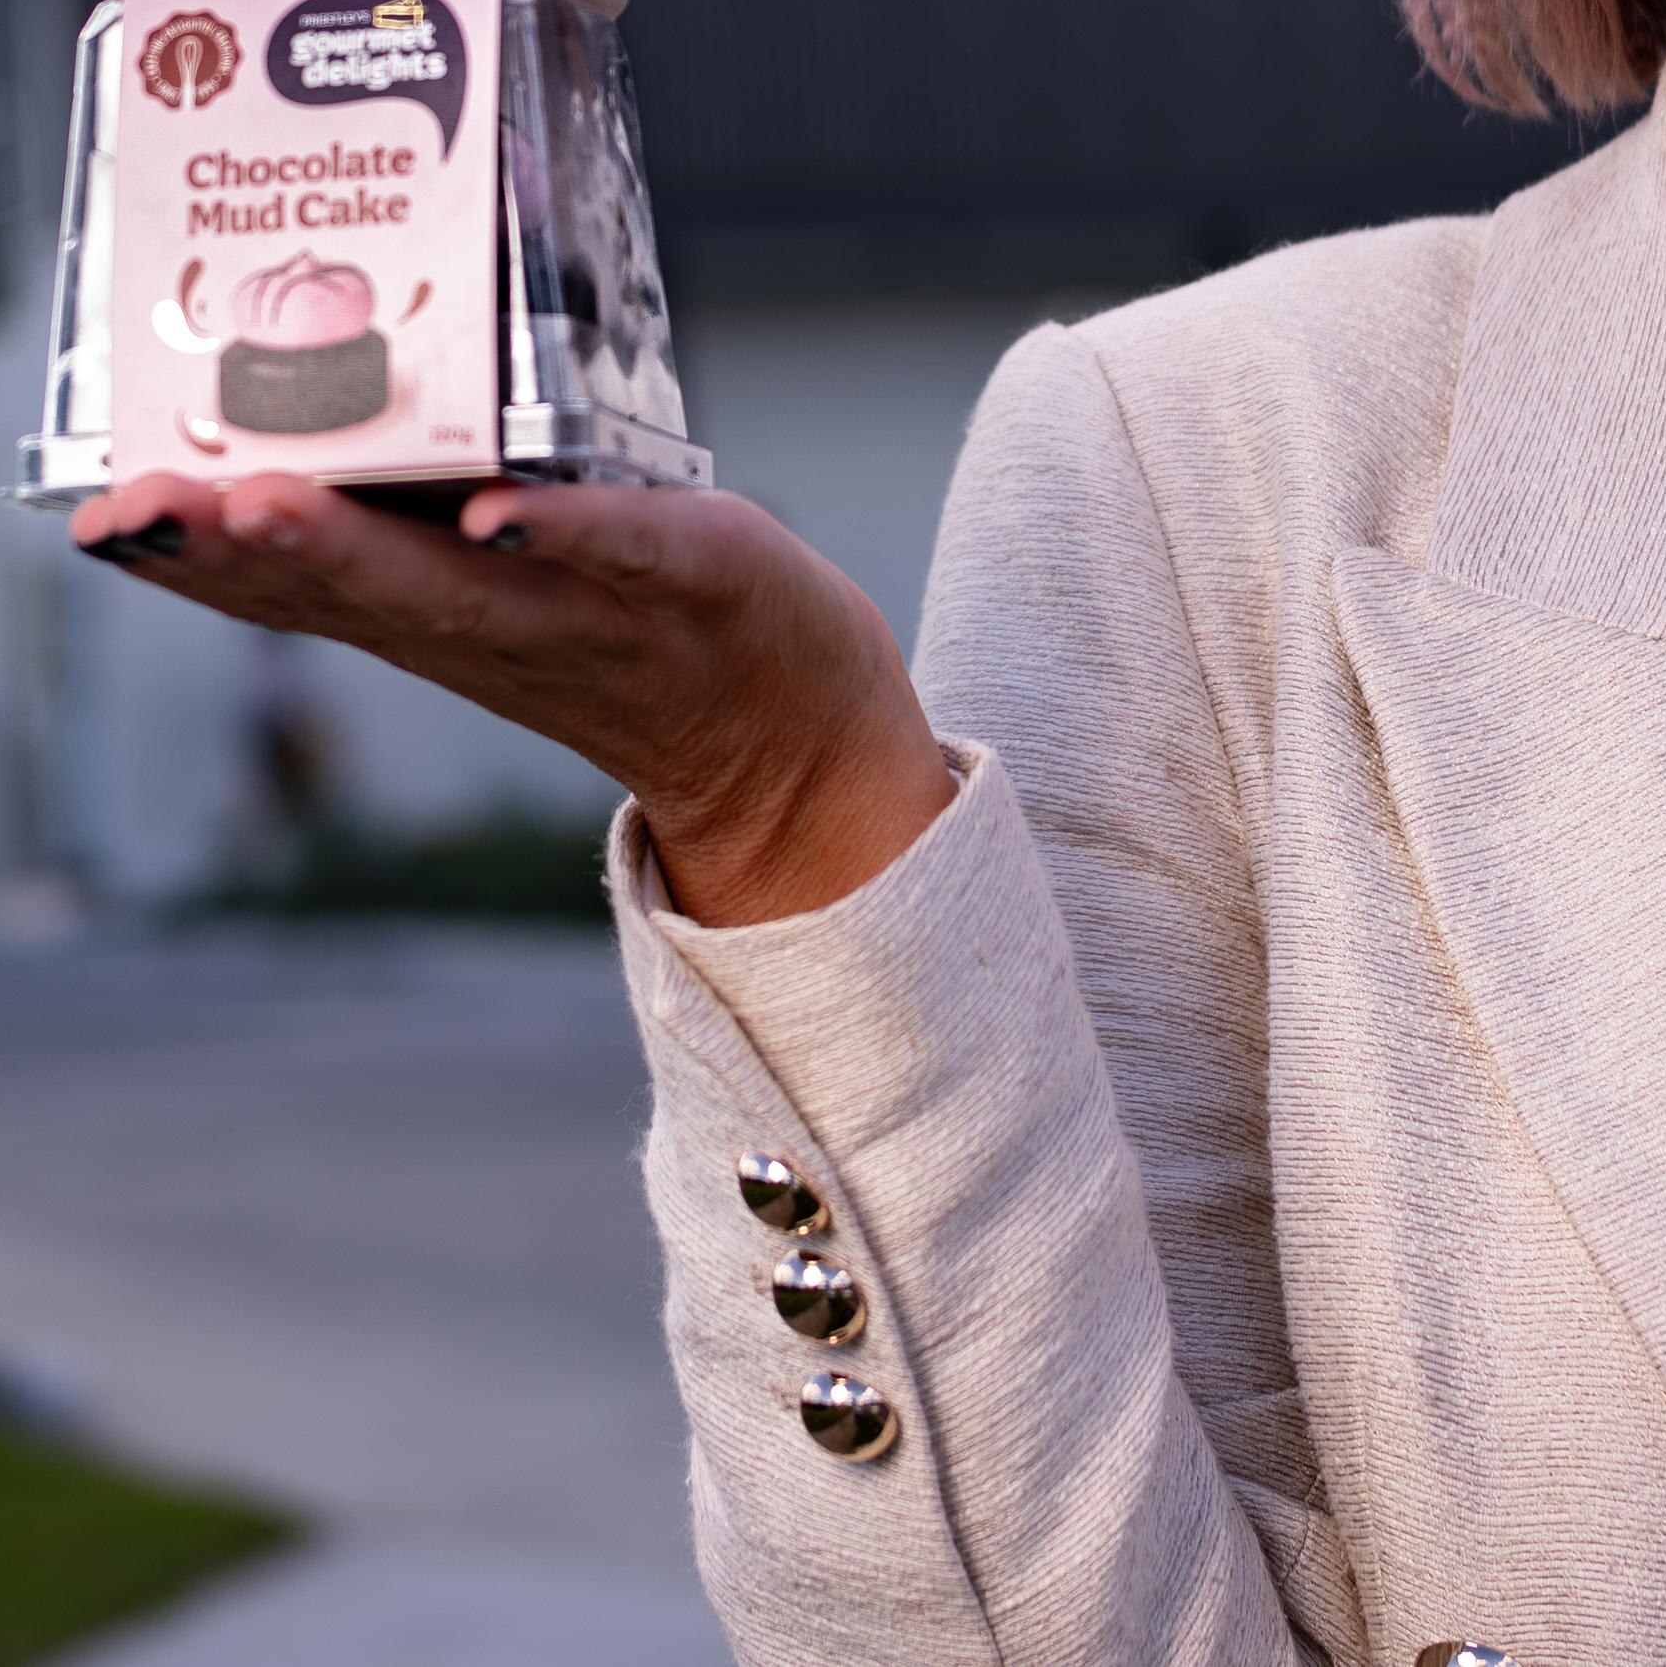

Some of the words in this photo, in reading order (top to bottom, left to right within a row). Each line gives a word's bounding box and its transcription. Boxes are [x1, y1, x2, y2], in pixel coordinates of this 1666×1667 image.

[290, 20, 437, 67] gourmet
[302, 51, 448, 91] delights
[186, 141, 416, 189] Chocolate
[187, 192, 286, 237] Mud
[296, 187, 411, 231] Cake
